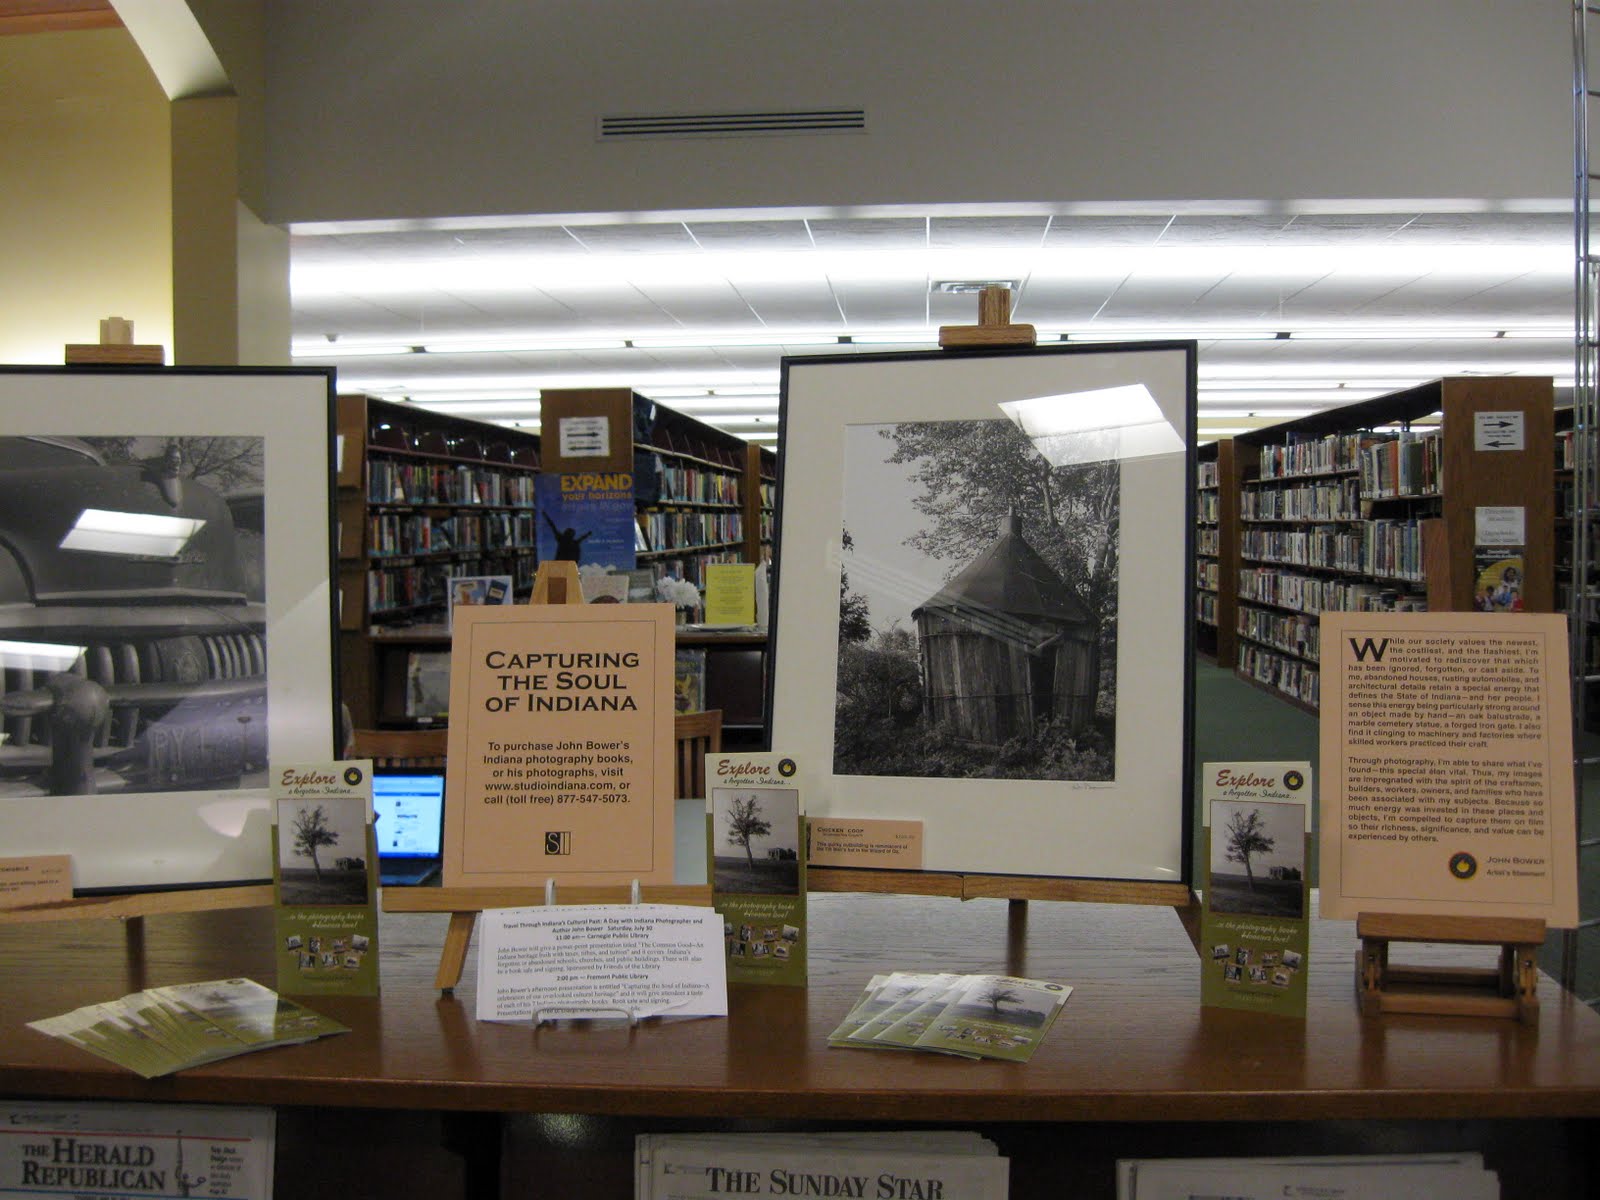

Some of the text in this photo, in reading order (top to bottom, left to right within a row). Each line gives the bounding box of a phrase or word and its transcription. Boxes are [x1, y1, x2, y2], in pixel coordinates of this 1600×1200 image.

[561, 474, 633, 492] EXPAND
[562, 493, 585, 501] your
[1425, 638, 1455, 646] society
[485, 649, 639, 669] CAPTURING
[1388, 665, 1422, 673] ignored,
[1425, 666, 1464, 674] forgotten,
[496, 670, 626, 690] THE SOUL
[1441, 675, 1469, 683] rusting
[1462, 684, 1490, 693] special
[484, 692, 636, 712] OF INDIANA
[1416, 702, 1438, 710] being
[1439, 703, 1483, 711] particularly
[1484, 703, 1511, 712] strong
[1360, 710, 1386, 719] object
[1414, 711, 1424, 719] by
[1376, 720, 1413, 728] cemetery
[1451, 721, 1477, 730] forged
[1372, 729, 1405, 738] clinging
[1417, 730, 1459, 739] machinery
[487, 741, 629, 753] To purchase John Bower's
[1409, 739, 1446, 748] practiced
[483, 754, 632, 766] Indiana photography books,
[506, 768, 523, 777] his
[525, 767, 597, 779] photographs,
[600, 767, 623, 776] visit
[717, 759, 770, 778] Explore
[282, 770, 336, 788] Explore
[728, 777, 754, 786] forgotten
[1216, 770, 1275, 790] Explore
[484, 781, 616, 791] www.studioindiana.com,
[294, 787, 320, 797] forgotten
[1228, 789, 1257, 799] forgotten
[483, 794, 630, 806] call (toll free) 877-547-5073.
[22, 1138, 154, 1166] THE HERALD
[22, 1160, 166, 1190] REPUBLICAN
[706, 1167, 761, 1194] THE
[770, 1169, 870, 1197] SUNDAY
[877, 1174, 944, 1200] STAR
